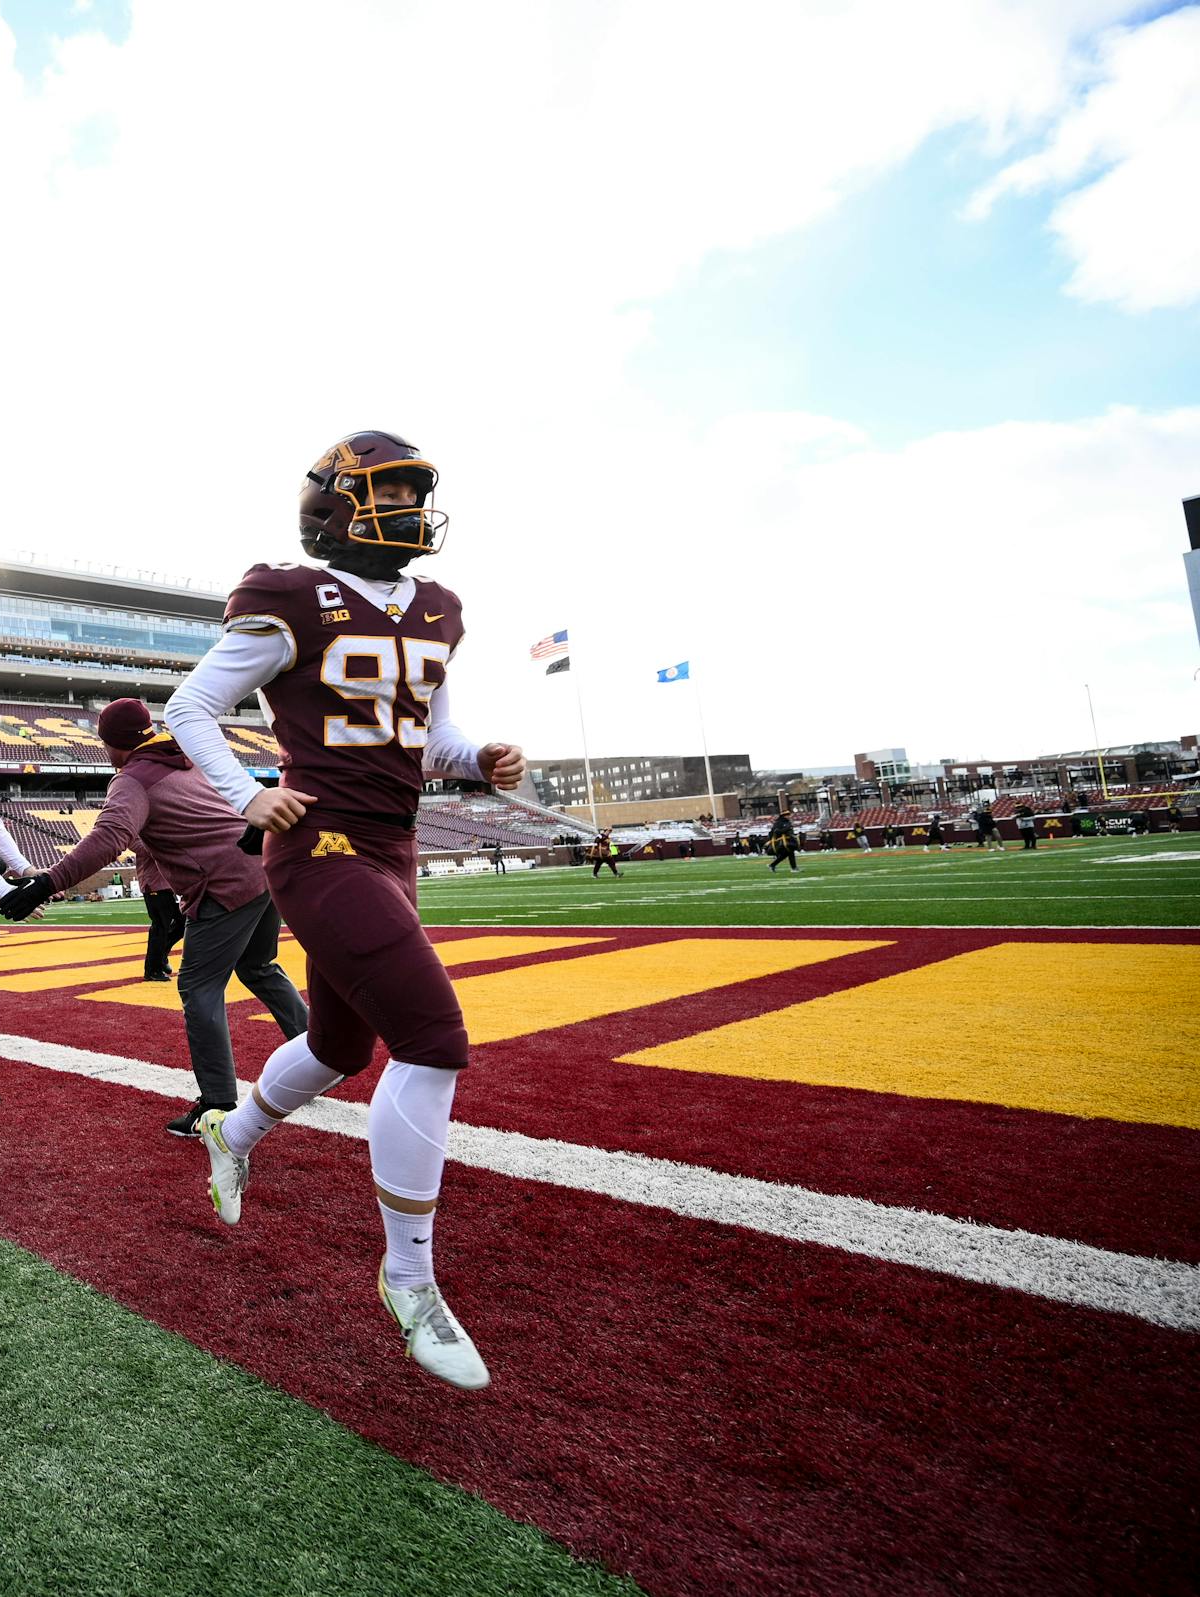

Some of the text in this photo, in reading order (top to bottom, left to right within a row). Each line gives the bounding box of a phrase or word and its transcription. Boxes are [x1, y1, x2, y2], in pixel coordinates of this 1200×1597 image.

[317, 584, 344, 608] C
[2, 636, 137, 656] HUNTINGTON BANK STADIUM
[320, 634, 450, 749] 95
